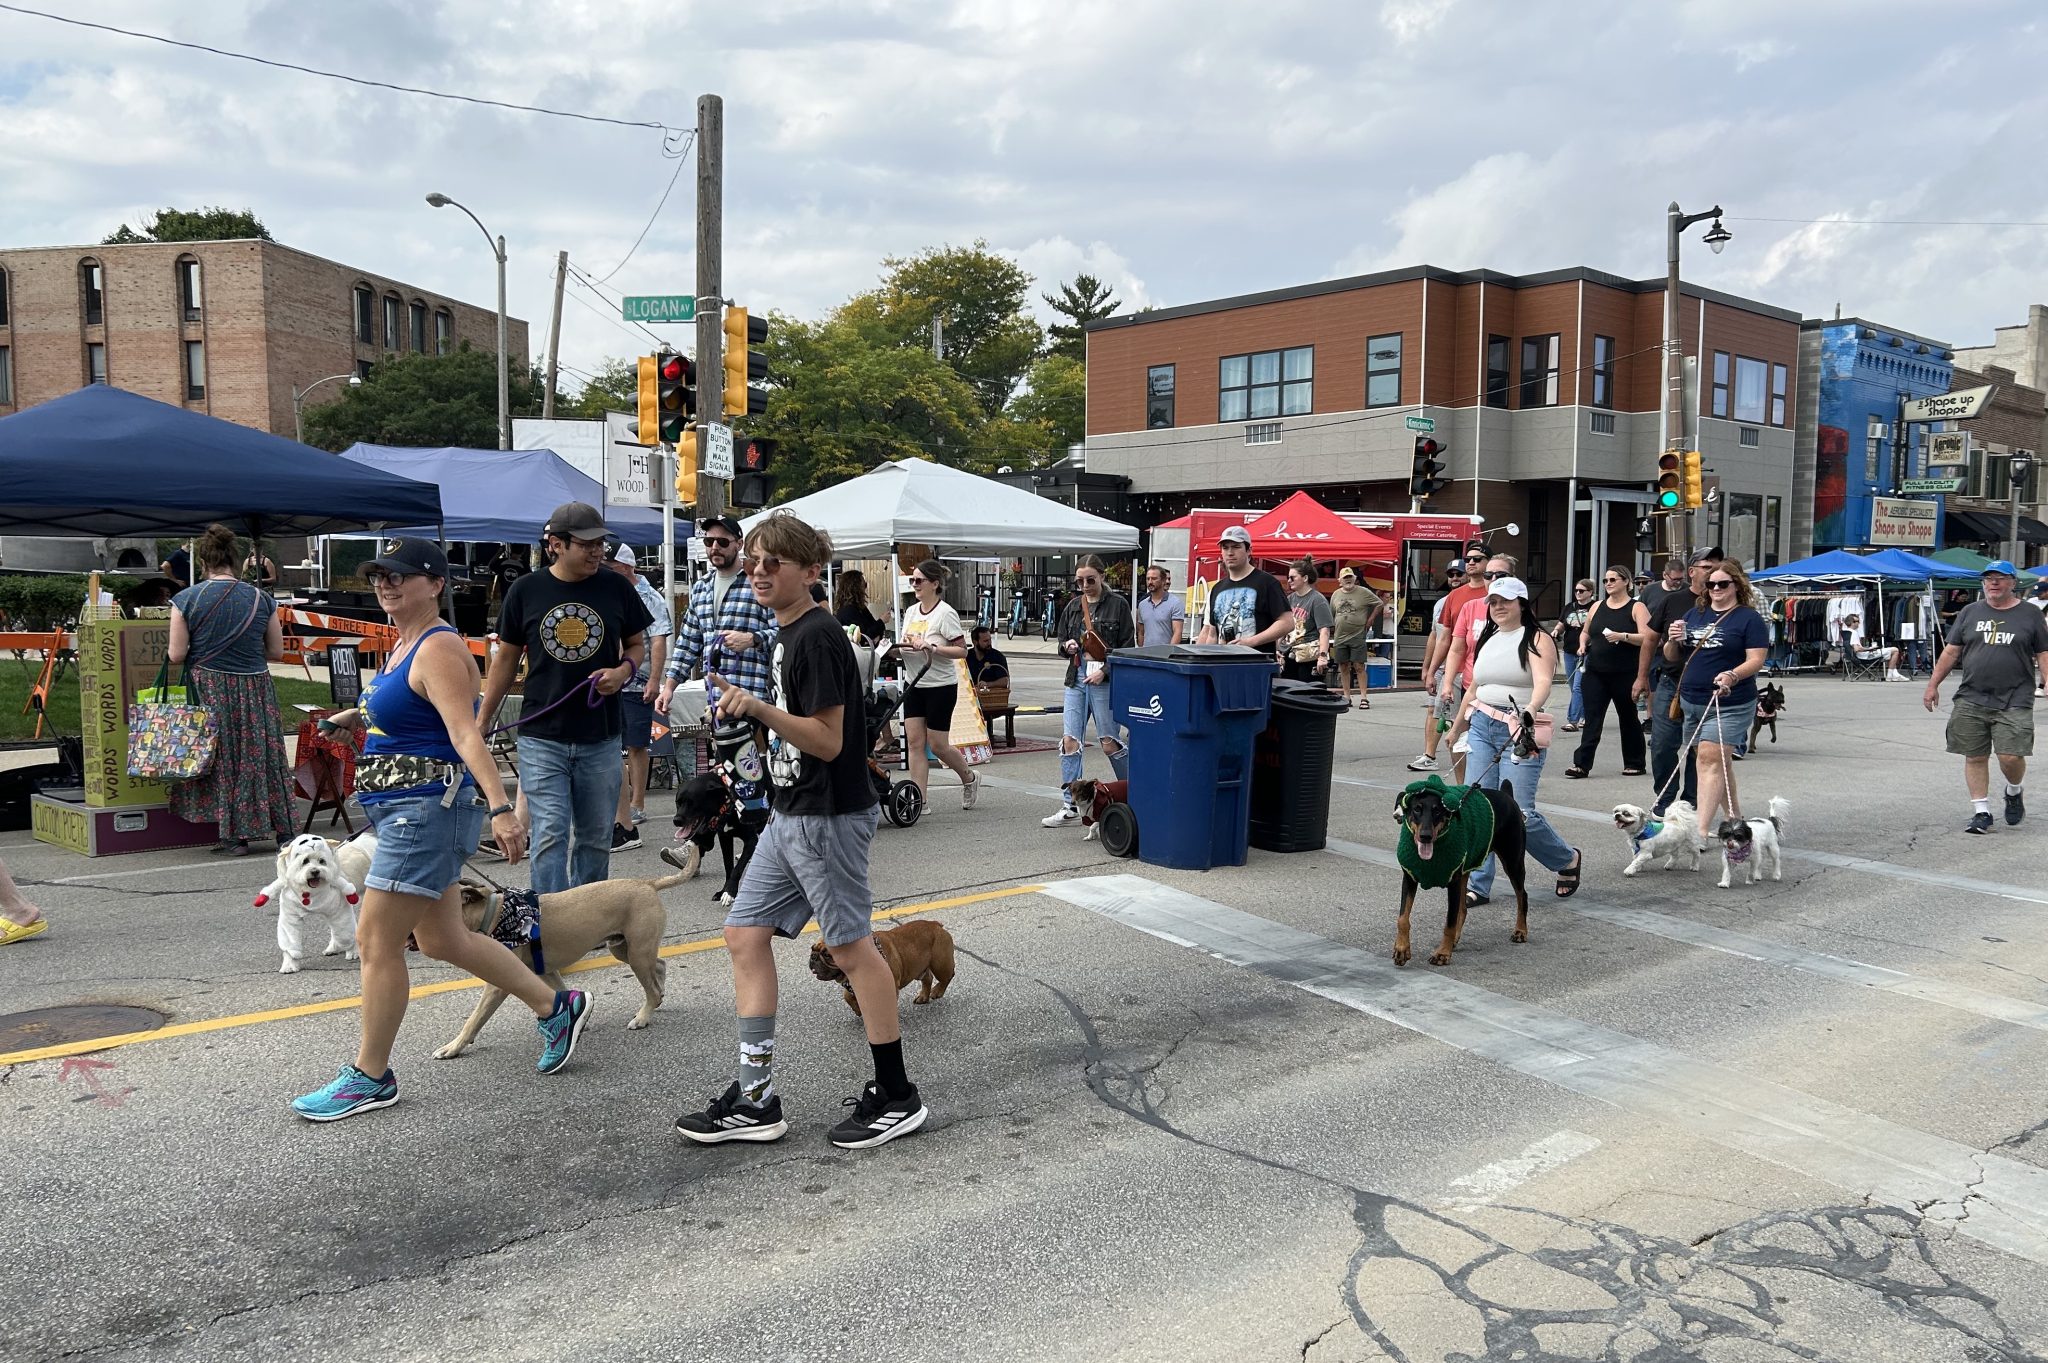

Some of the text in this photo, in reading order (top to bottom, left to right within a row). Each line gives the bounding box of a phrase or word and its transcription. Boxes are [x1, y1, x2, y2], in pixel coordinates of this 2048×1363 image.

[627, 300, 690, 317] S LOGAN AV
[1925, 397, 1957, 408] Shape
[1961, 396, 1974, 406] up
[1928, 406, 1967, 416] Shoppe
[714, 426, 728, 435] PUSH
[710, 434, 732, 446] BUTTON
[715, 445, 727, 453] FOR
[712, 453, 729, 463] WALK
[709, 462, 733, 472] SIGNAL
[1876, 502, 1888, 516] The
[1890, 506, 1908, 516] AEROBIC
[1875, 519, 1932, 539] Shape up Shoppe
[332, 618, 400, 639] STREET CLOS
[1984, 632, 2015, 645] VIEW
[101, 627, 116, 672] WORDS
[332, 647, 357, 676] POEMS
[101, 683, 117, 733] WORDS
[104, 747, 120, 800] WORDS
[35, 803, 88, 848] CUSTOM POETRY
